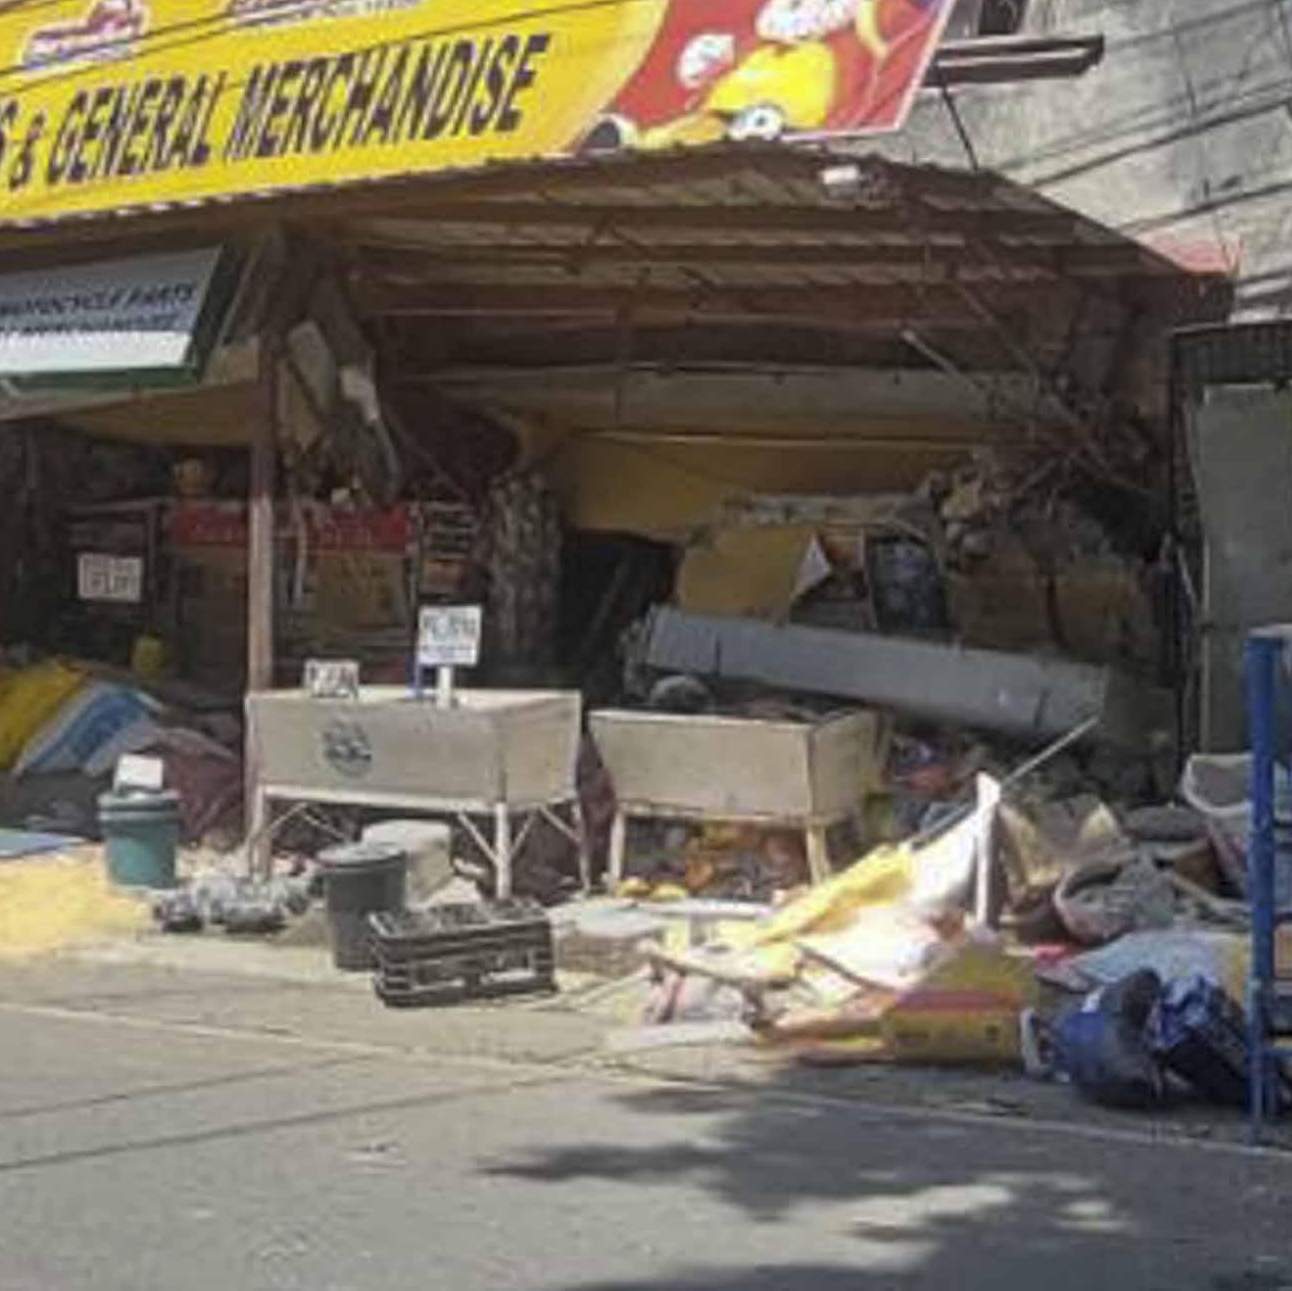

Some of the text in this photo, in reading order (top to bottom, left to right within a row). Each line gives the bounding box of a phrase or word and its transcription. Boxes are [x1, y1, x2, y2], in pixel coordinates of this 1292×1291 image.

[9, 112, 47, 191] &
[47, 71, 227, 187] GENERAL
[223, 32, 552, 162] MERCHANDISE
